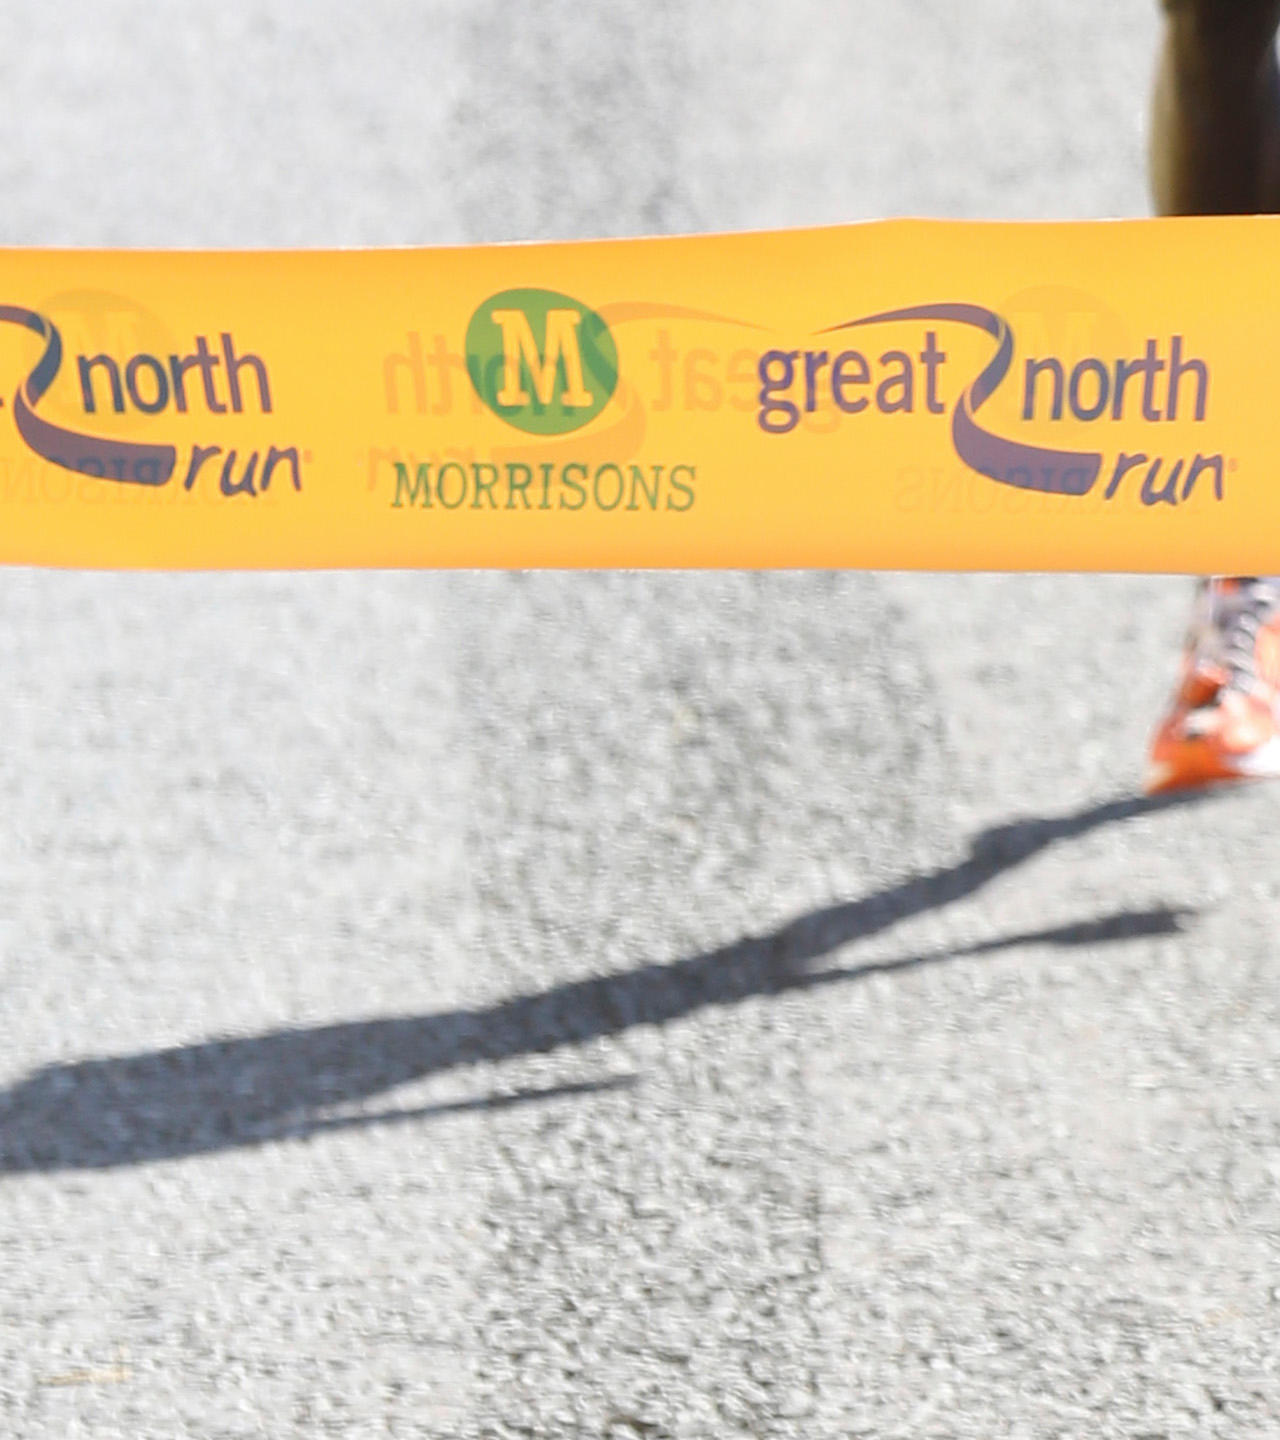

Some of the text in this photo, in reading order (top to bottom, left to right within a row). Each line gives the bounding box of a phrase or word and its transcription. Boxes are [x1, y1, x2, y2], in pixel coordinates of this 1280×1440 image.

[76, 331, 273, 414] north
[757, 330, 1208, 434] great north
[183, 444, 302, 498] run
[391, 462, 697, 511] MORRISONS
[1104, 451, 1224, 507] run
